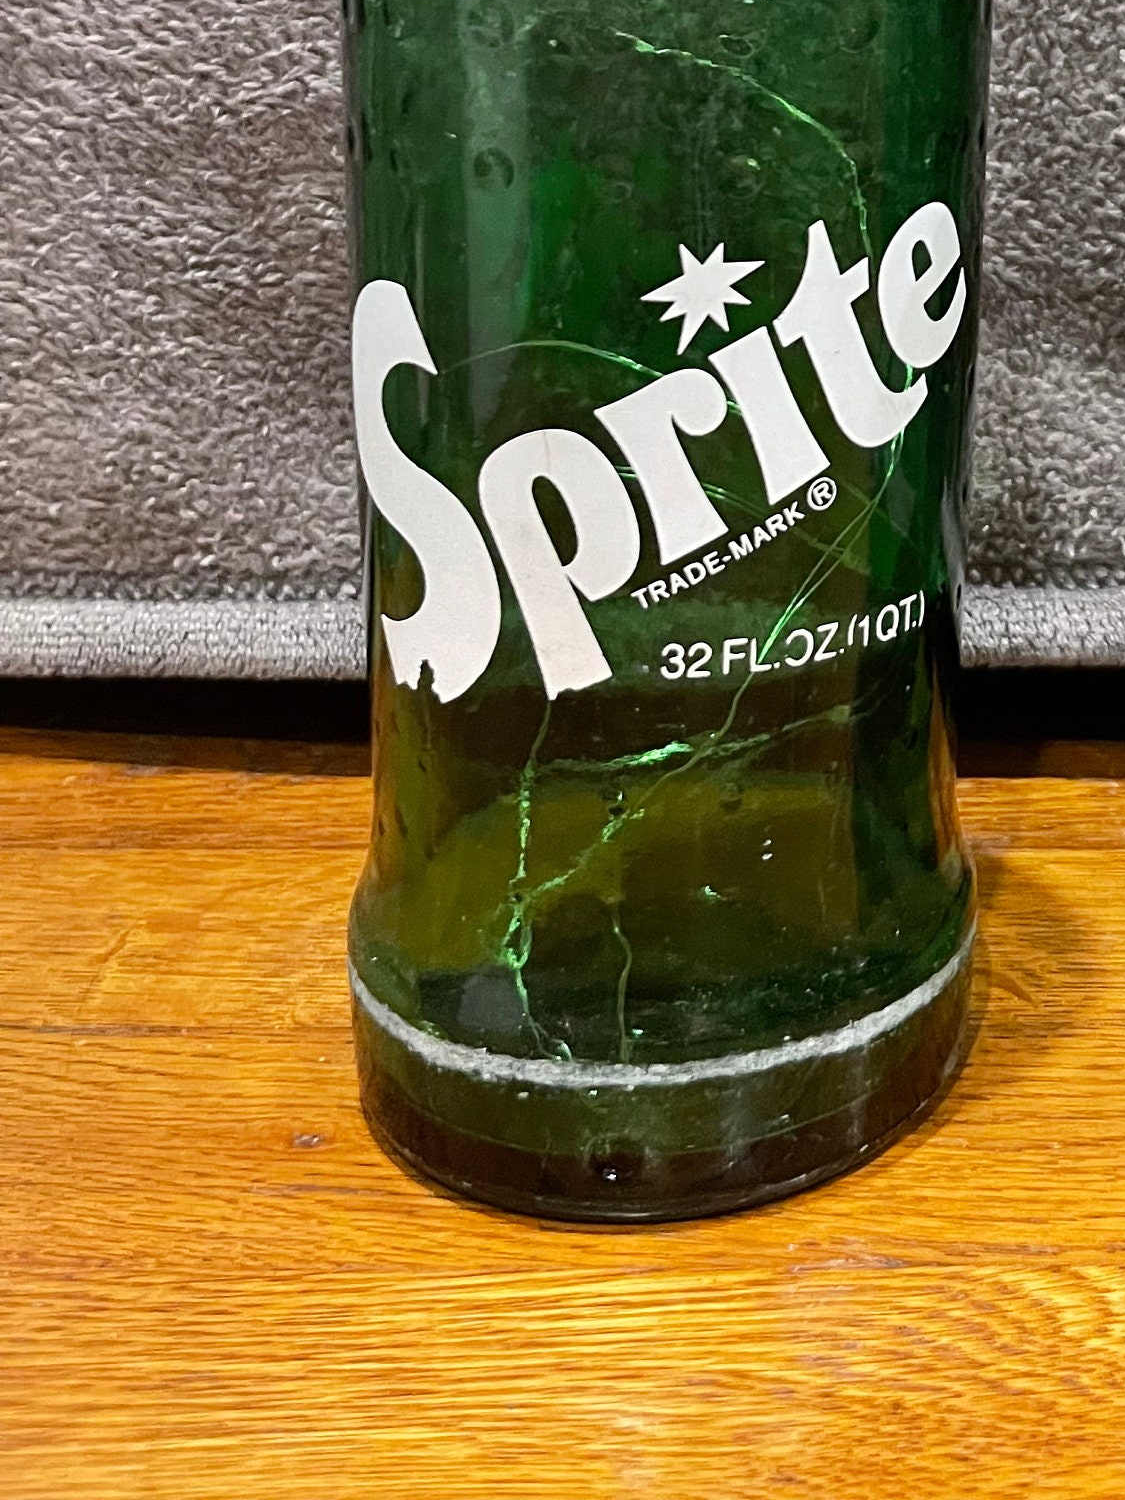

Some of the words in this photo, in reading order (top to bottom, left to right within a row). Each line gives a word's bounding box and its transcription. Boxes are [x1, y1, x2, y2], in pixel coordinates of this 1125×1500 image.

[352, 202, 967, 704] Sprite
[631, 501, 806, 609] TRADE-MARK
[660, 642, 713, 680] 32
